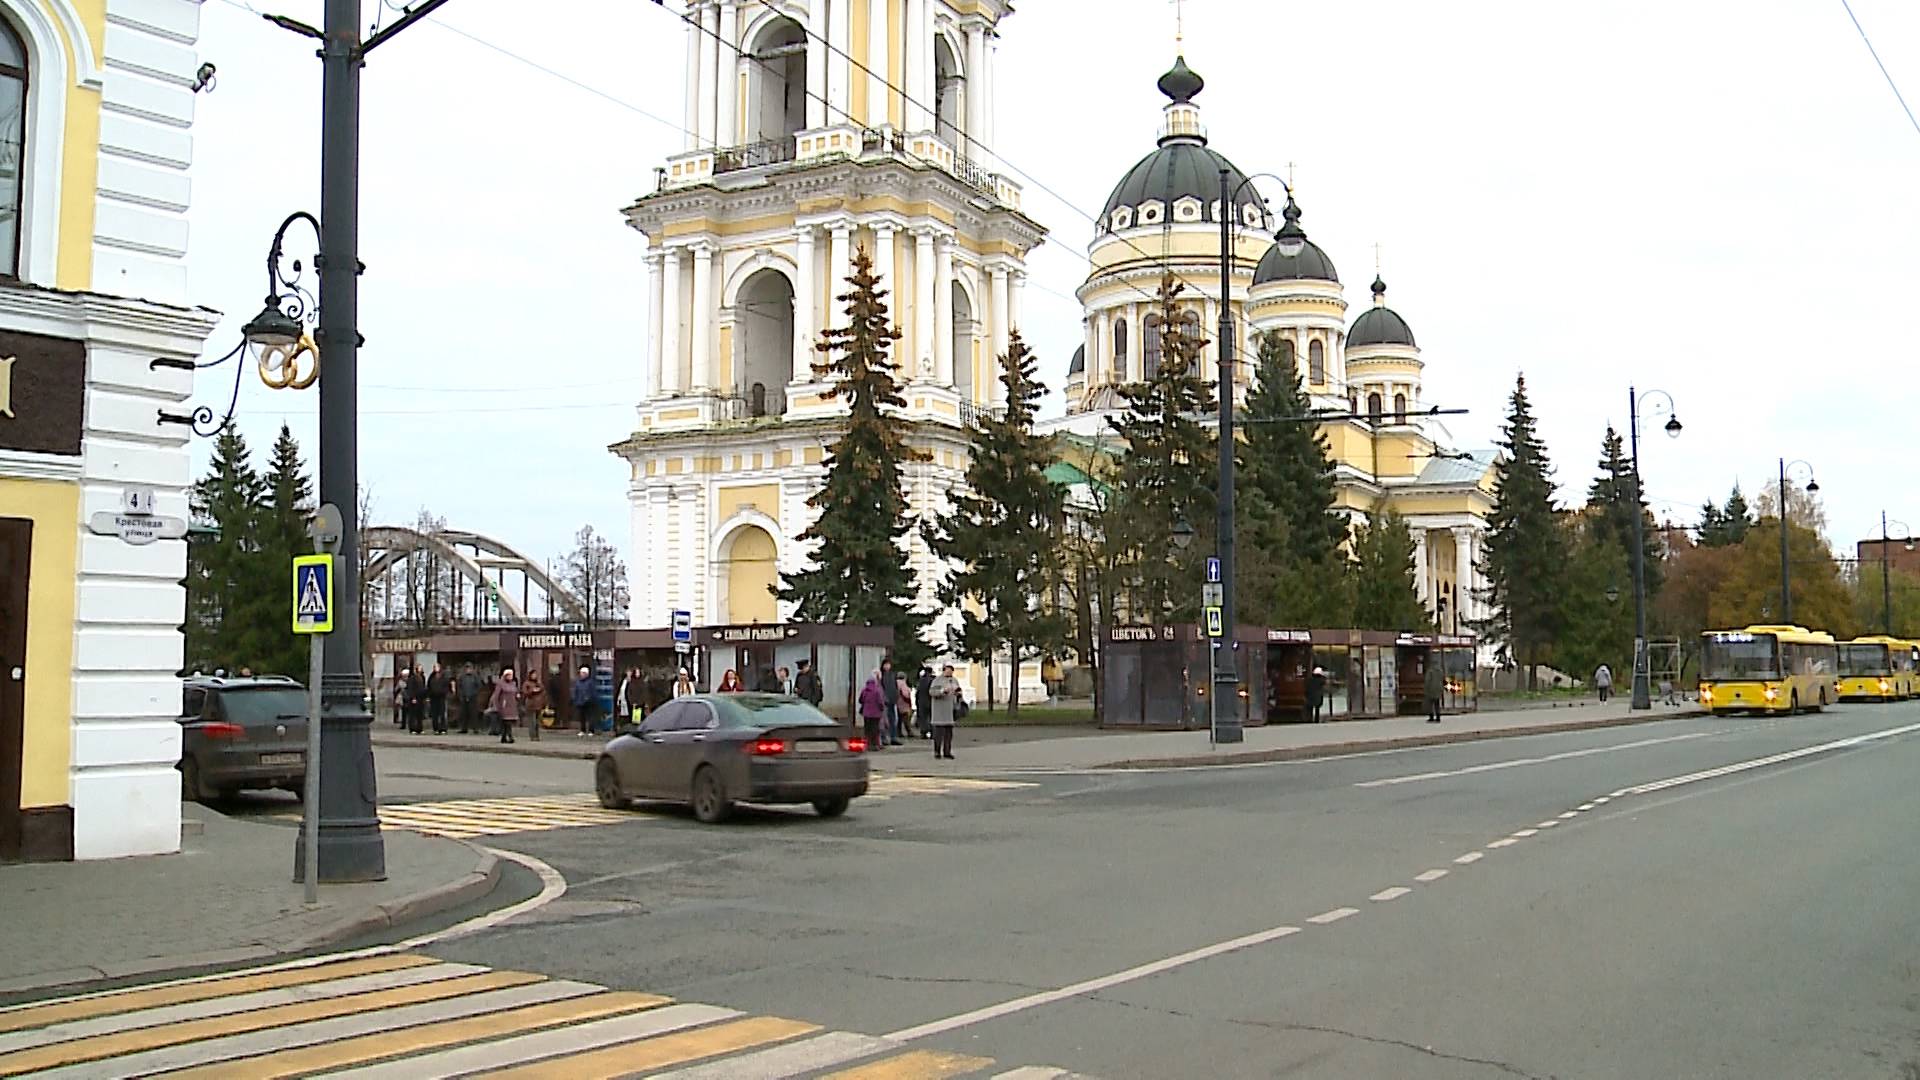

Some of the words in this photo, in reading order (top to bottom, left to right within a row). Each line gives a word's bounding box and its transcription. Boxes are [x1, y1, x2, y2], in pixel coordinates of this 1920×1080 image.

[130, 493, 138, 508] 4
[115, 517, 163, 528] Крестовая
[125, 529, 153, 537] улица
[1111, 626, 1157, 640] ЦВЕТОКЪ
[519, 635, 566, 648] РЫБИНСКАЯ
[568, 633, 593, 647] РЫБА
